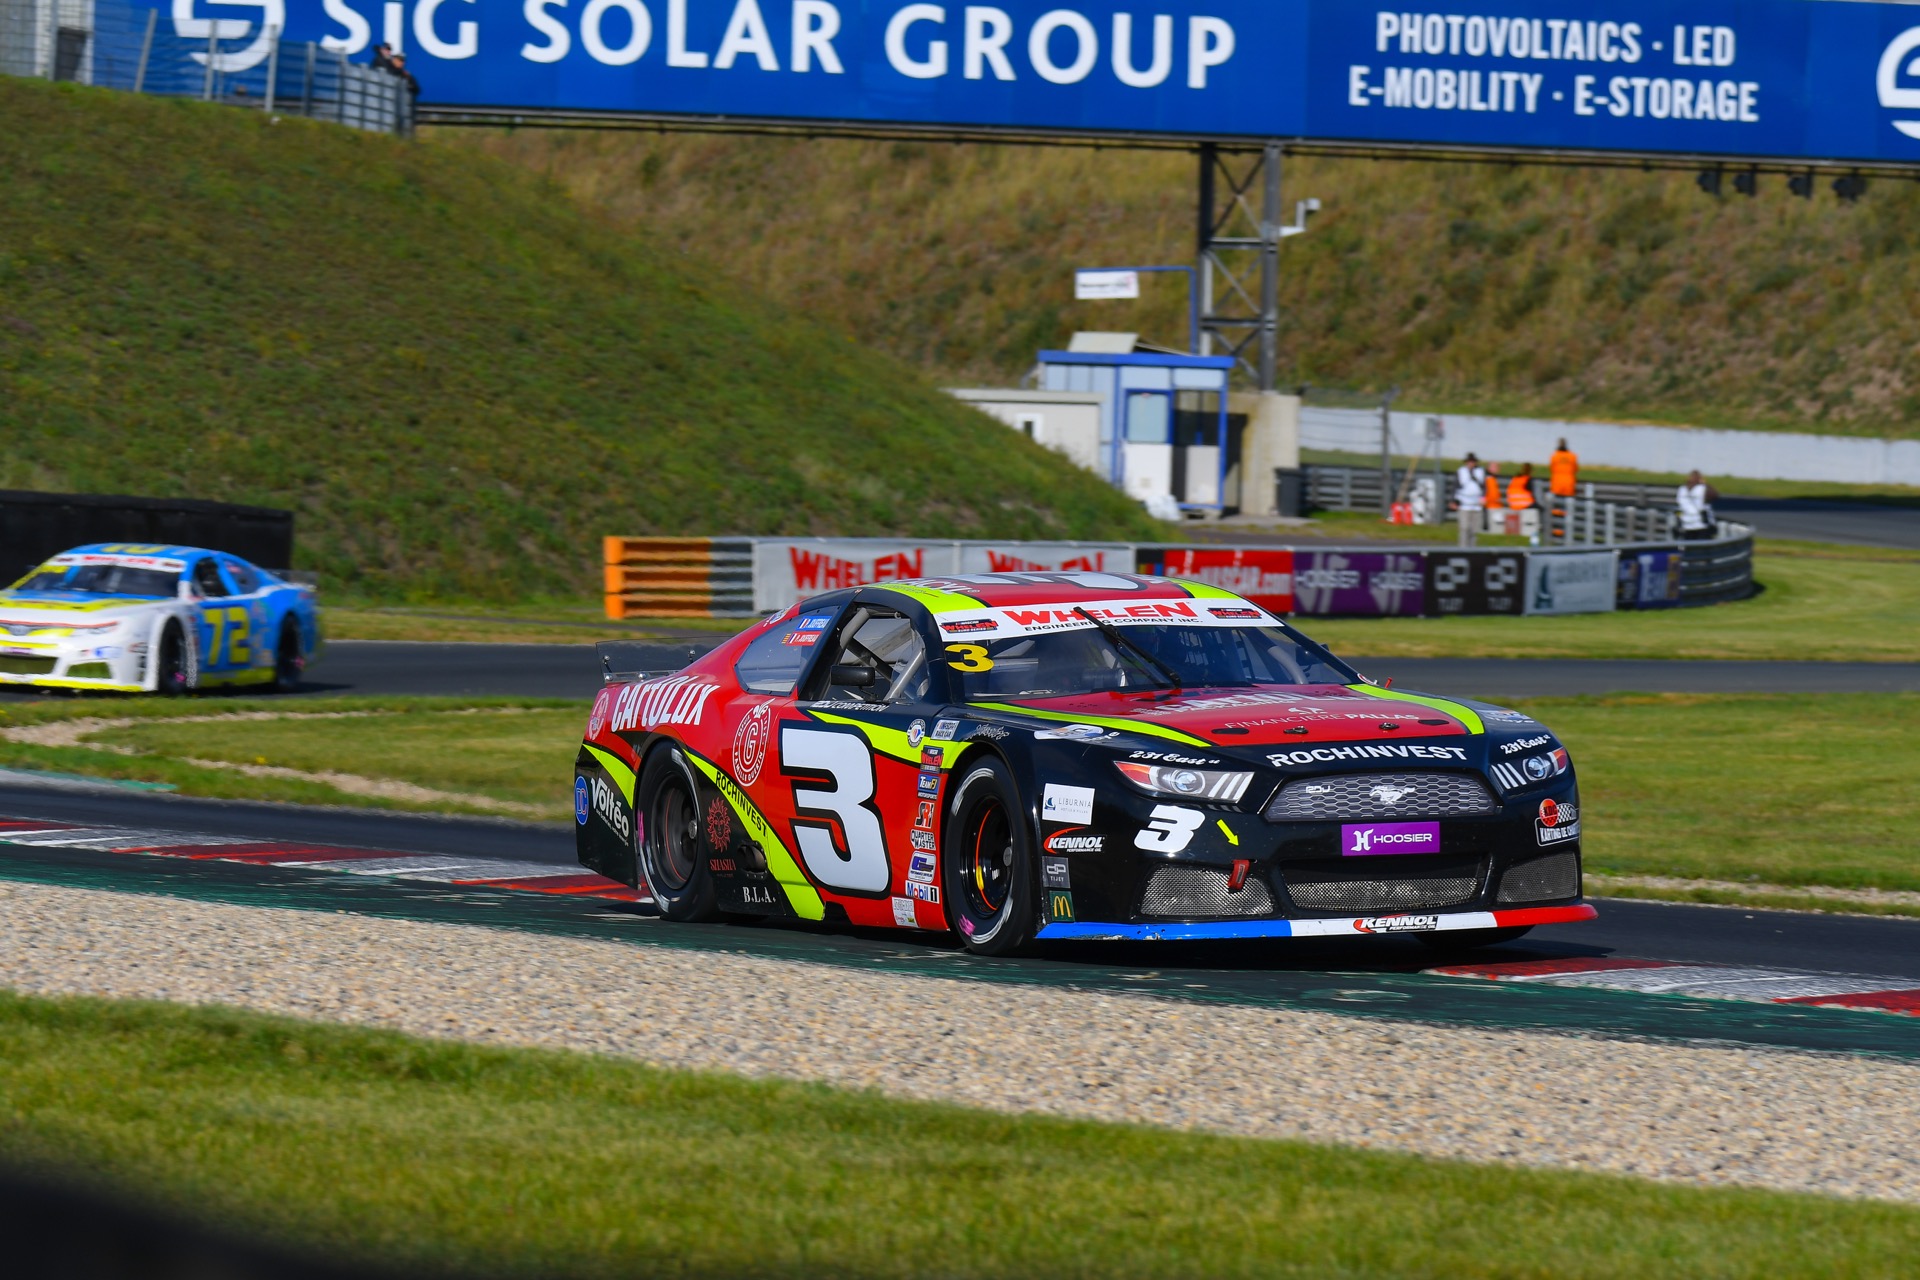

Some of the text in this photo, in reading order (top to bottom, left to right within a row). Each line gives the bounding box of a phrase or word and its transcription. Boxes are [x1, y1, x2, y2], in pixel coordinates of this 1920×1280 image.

[520, 0, 846, 75] SOLAR
[884, 3, 1236, 89] GROUP
[1376, 12, 1642, 64] PHOTOVOLTAICS
[1672, 25, 1736, 68] LED
[1348, 65, 1543, 114] E-MOBILITY
[1574, 75, 1760, 122] E-STORAGE
[788, 548, 926, 591] WHELEN
[1002, 601, 1199, 626] WHELEN
[1025, 619, 1111, 632] ENGINEERIG
[205, 607, 250, 667] 72
[944, 644, 995, 672] 3
[1344, 713, 1420, 721] PALLAS
[1128, 750, 1161, 760] 231
[1162, 752, 1206, 766] East
[1266, 745, 1468, 768] ROCHINVEST
[1500, 742, 1523, 755] 231
[1517, 737, 1547, 749] East
[715, 770, 767, 837] ROCHINVEST
[782, 728, 889, 892] 3
[1058, 797, 1091, 808] LIBURNIA
[1133, 804, 1206, 853] 3
[1374, 833, 1433, 844] HOOSIER
[1047, 836, 1103, 849] KENNOL
[907, 882, 937, 902] Mobil 1
[1360, 915, 1437, 929] KENNOL
